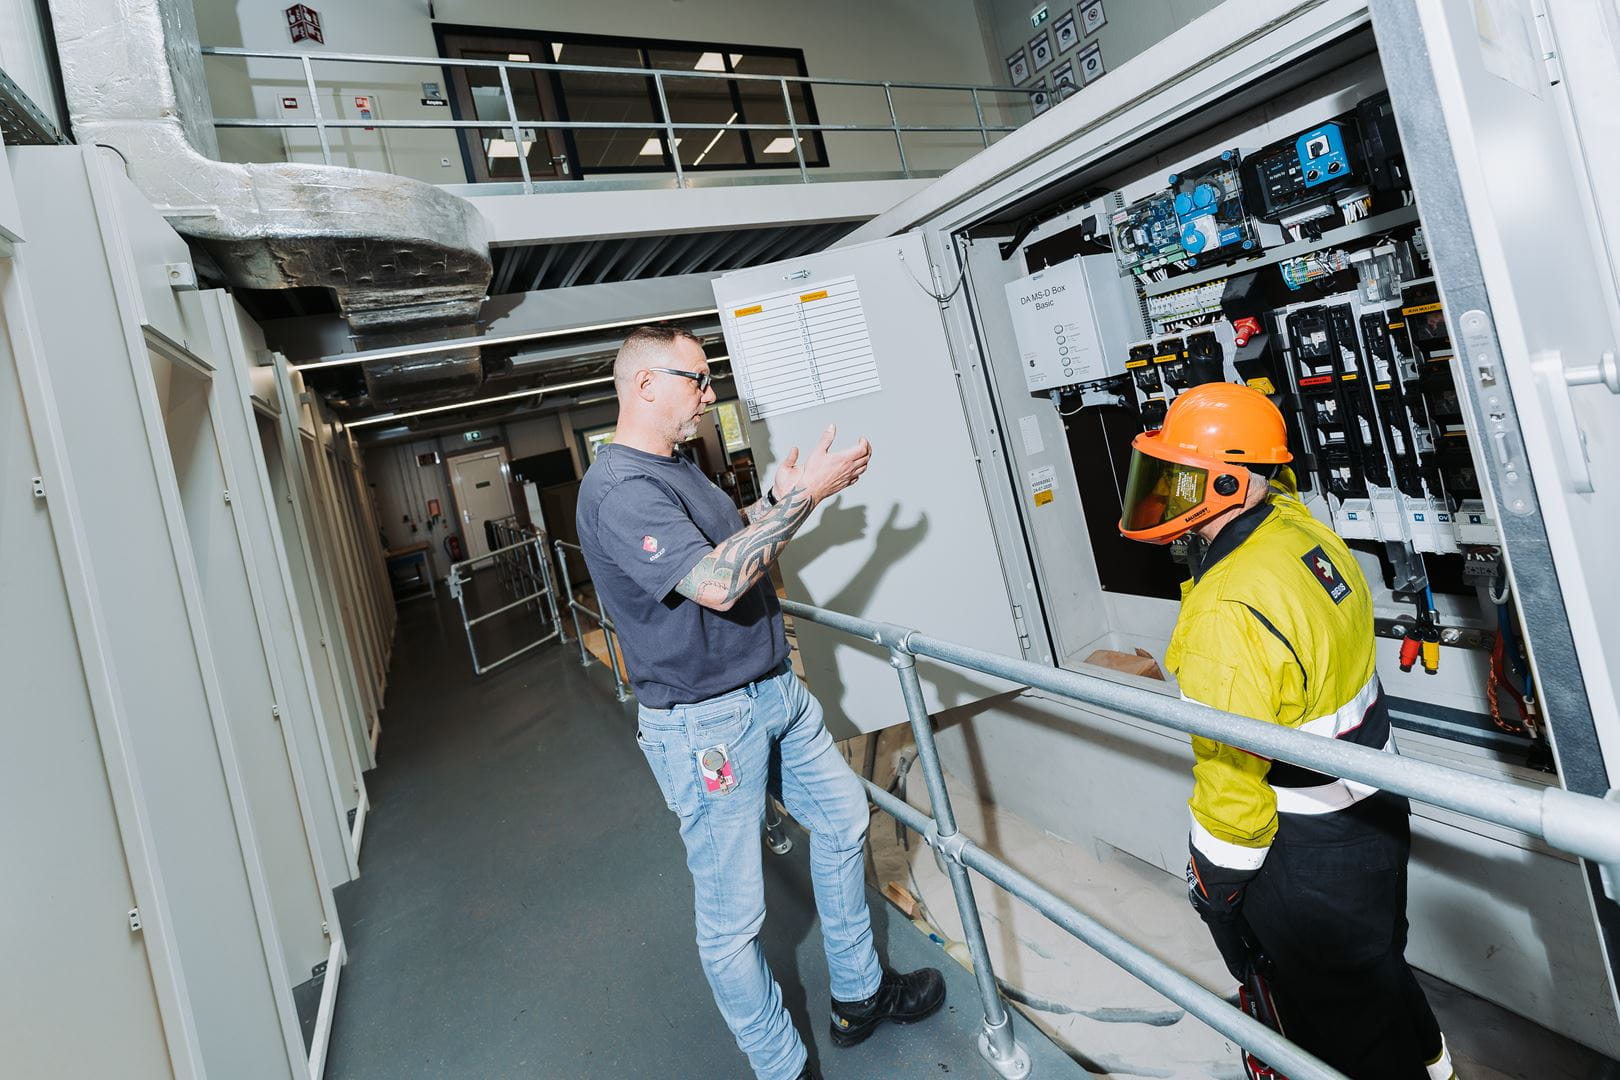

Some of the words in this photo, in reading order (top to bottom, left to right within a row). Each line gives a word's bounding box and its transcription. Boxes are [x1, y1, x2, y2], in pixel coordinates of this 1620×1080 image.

[1020, 295, 1031, 305] DA
[1031, 288, 1050, 301] MS-D
[1051, 285, 1066, 295] Box
[1035, 299, 1054, 310] Basic
